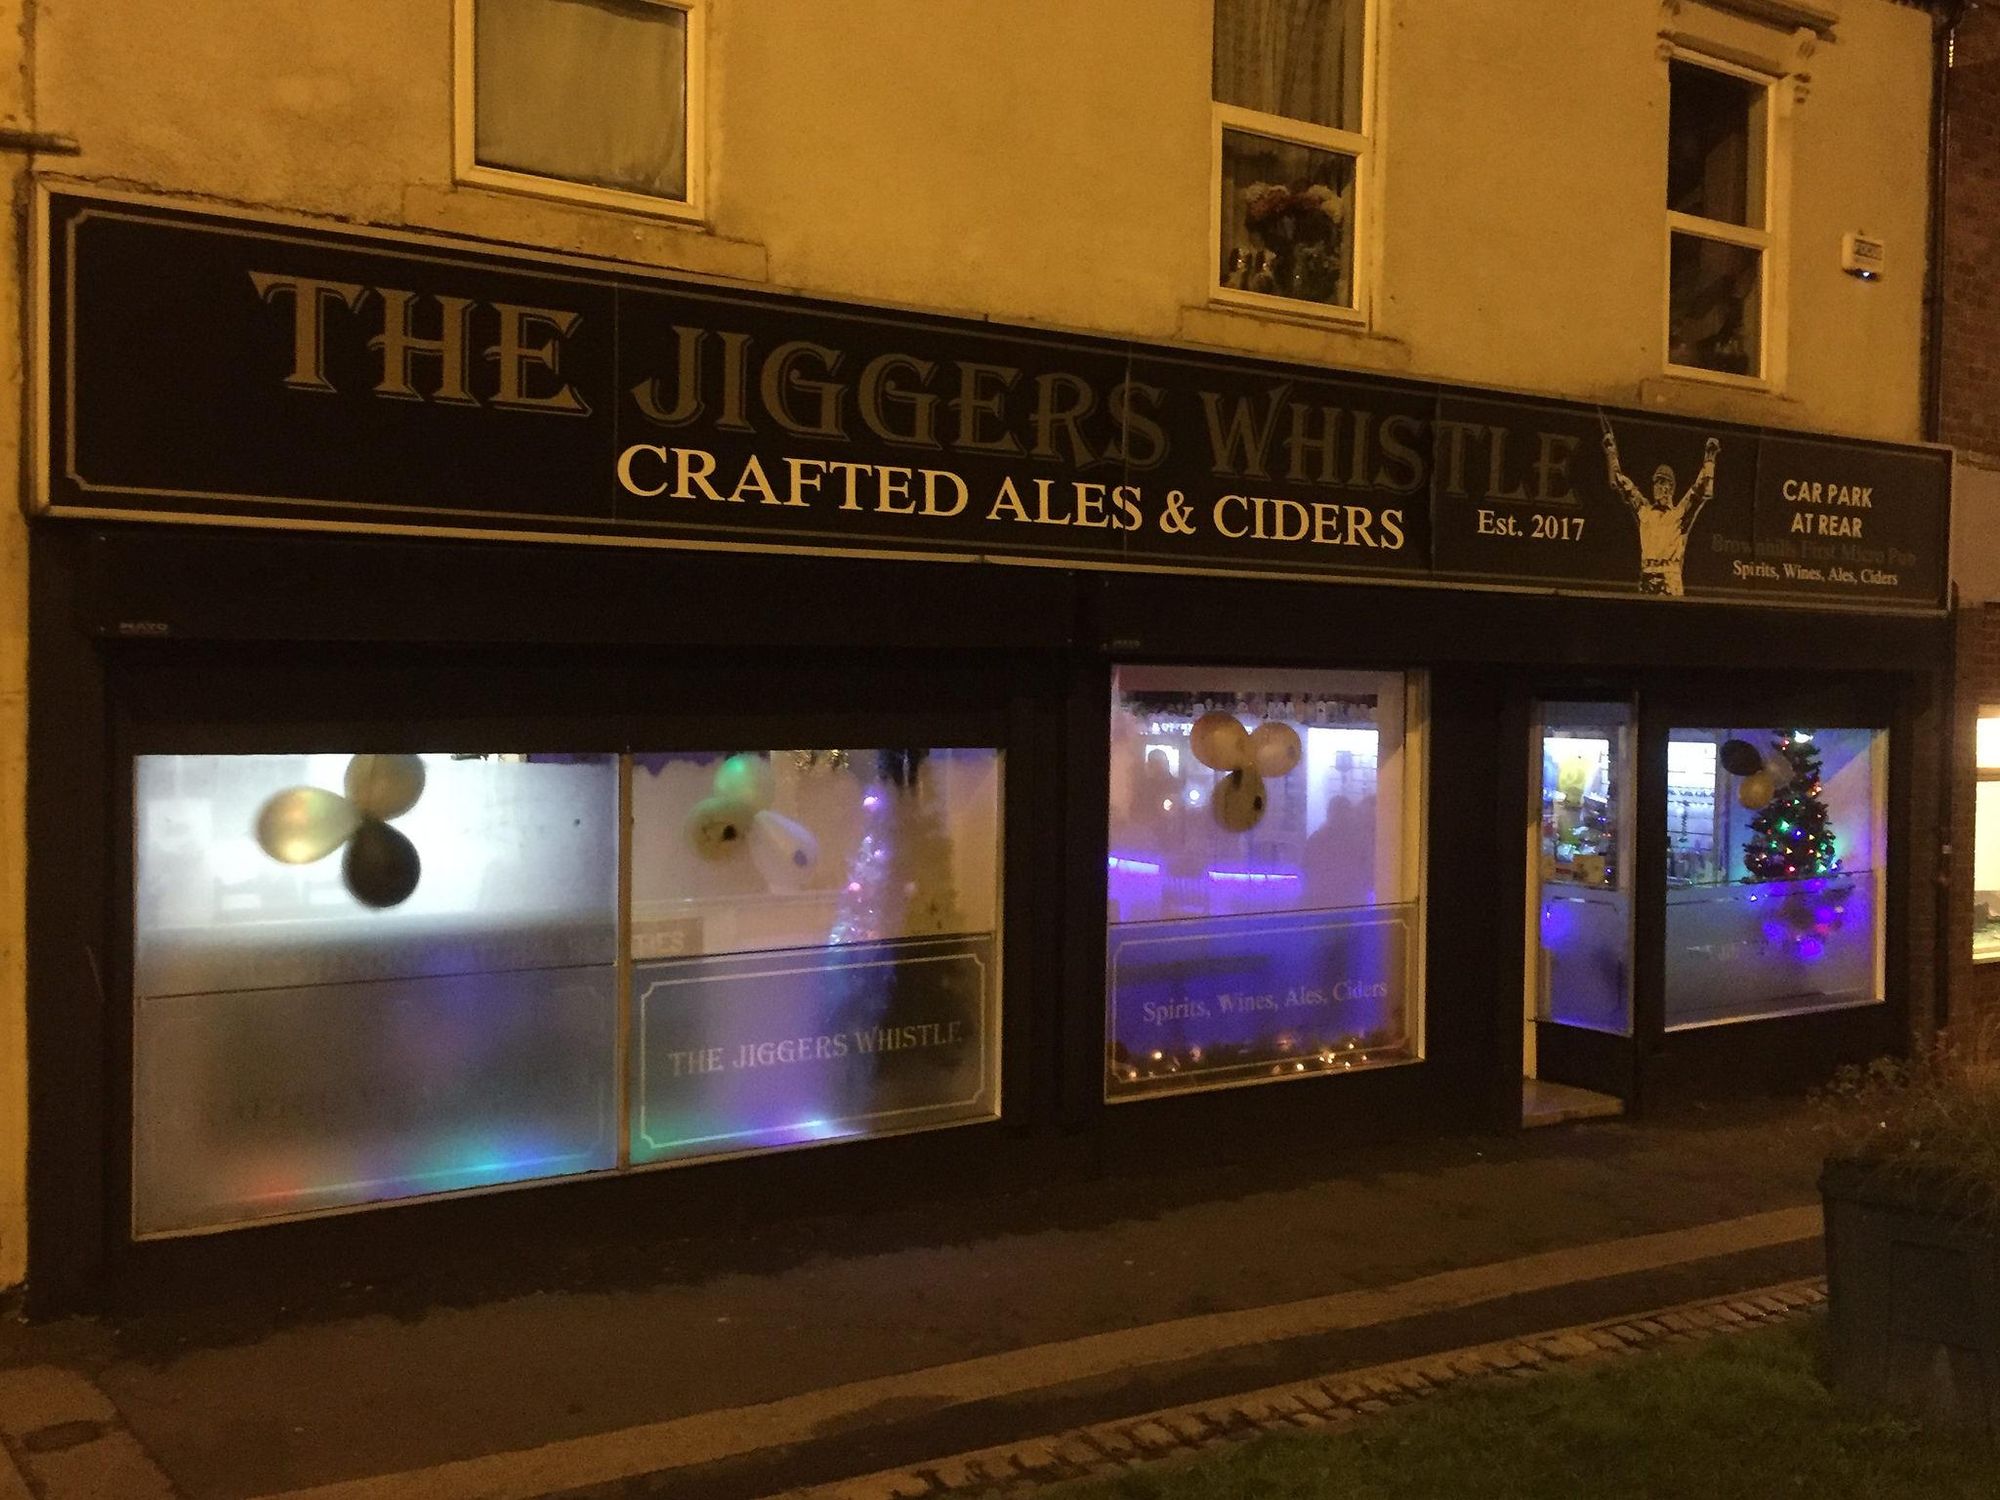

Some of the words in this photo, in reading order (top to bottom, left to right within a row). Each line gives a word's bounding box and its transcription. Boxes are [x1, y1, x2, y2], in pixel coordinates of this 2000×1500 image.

[248, 270, 592, 416] THE
[630, 325, 1171, 472] JIGGERS
[1200, 381, 1583, 508] WHISTLE
[616, 443, 970, 518] CRAFTED
[985, 476, 1143, 532] ALES
[1159, 489, 1197, 536] &
[1212, 494, 1405, 551] CIDERS
[1782, 479, 1822, 504] CAR
[1827, 483, 1873, 508] PARK
[1477, 509, 1523, 538] Est.
[1531, 515, 1585, 541] 2017
[1791, 512, 1814, 534] AT
[1818, 514, 1864, 538] REAR
[1332, 980, 1388, 1001] Ciders
[668, 1047, 724, 1077] THE
[732, 1033, 849, 1069] JIGGERS
[854, 1020, 963, 1055] WHISTLE
